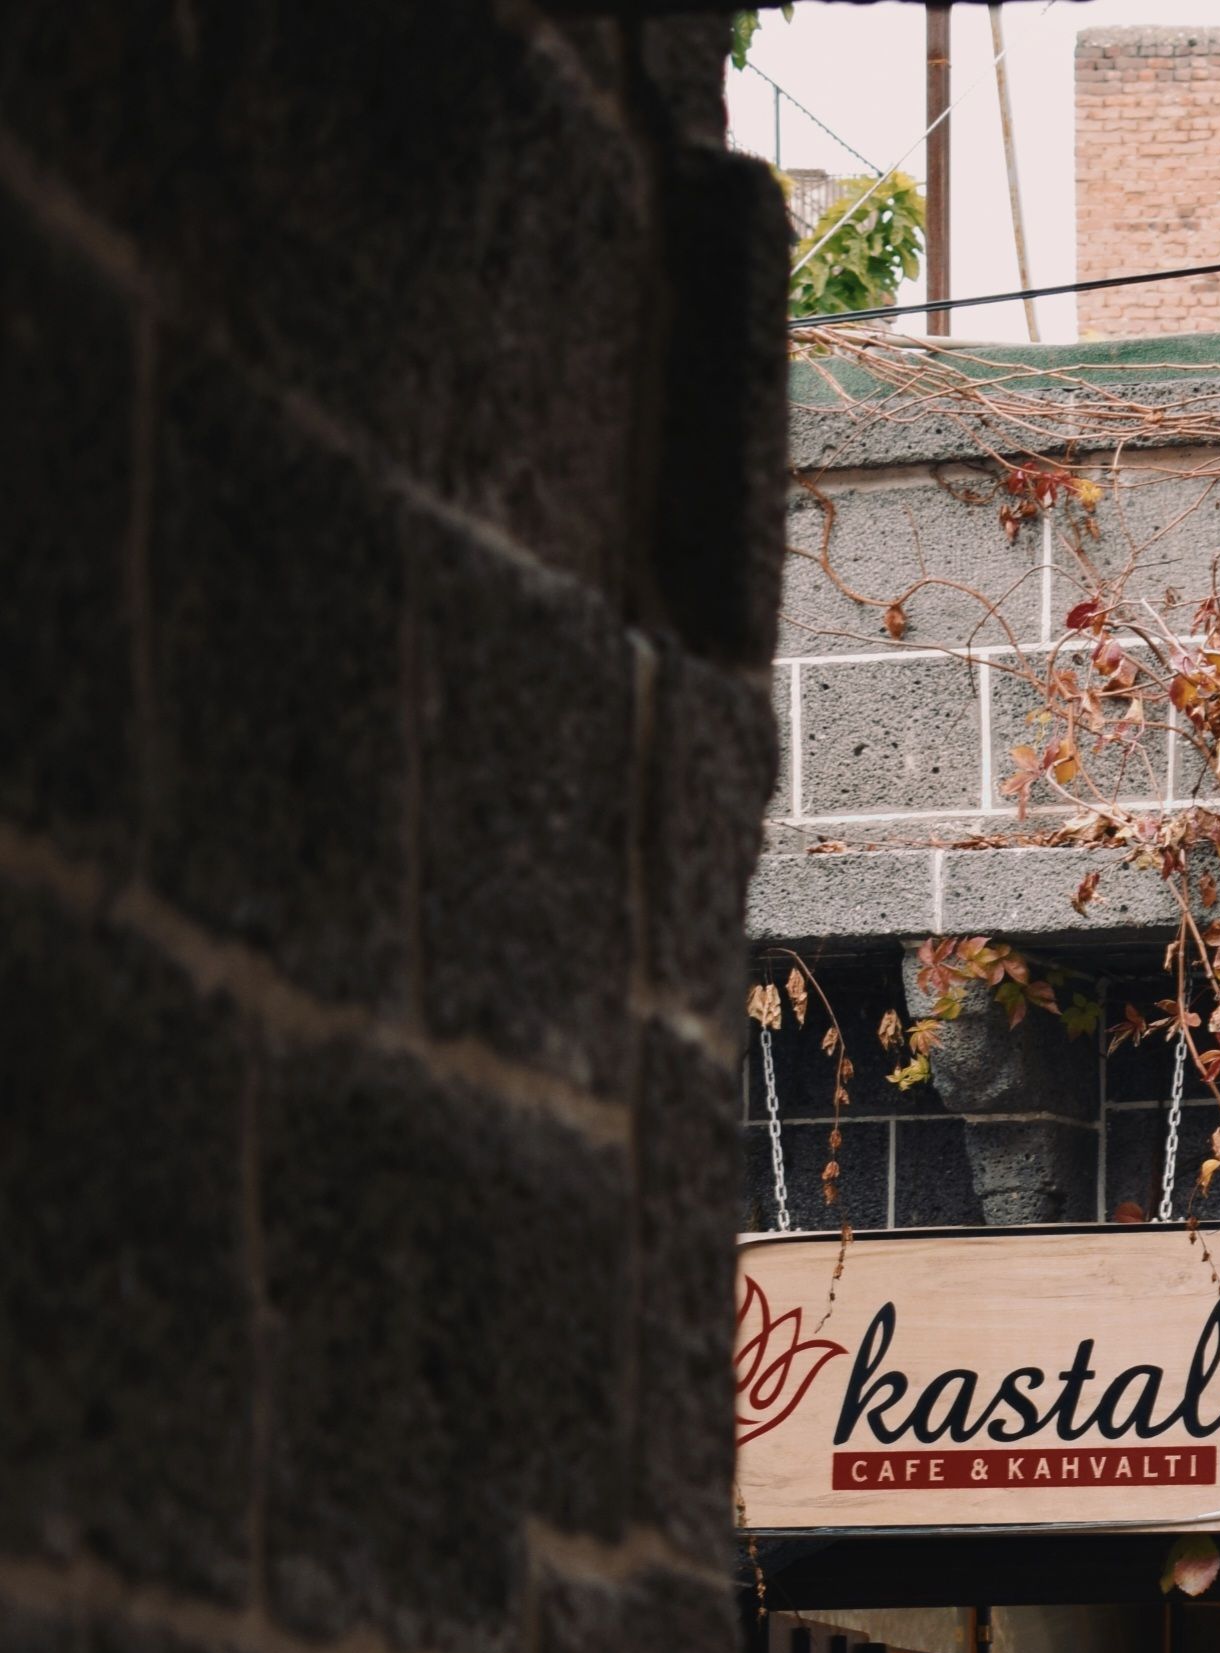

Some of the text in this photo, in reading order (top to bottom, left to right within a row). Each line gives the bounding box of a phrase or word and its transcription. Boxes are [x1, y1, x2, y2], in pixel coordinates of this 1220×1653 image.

[851, 1454, 1198, 1483] CAFE & KAHVALTI
